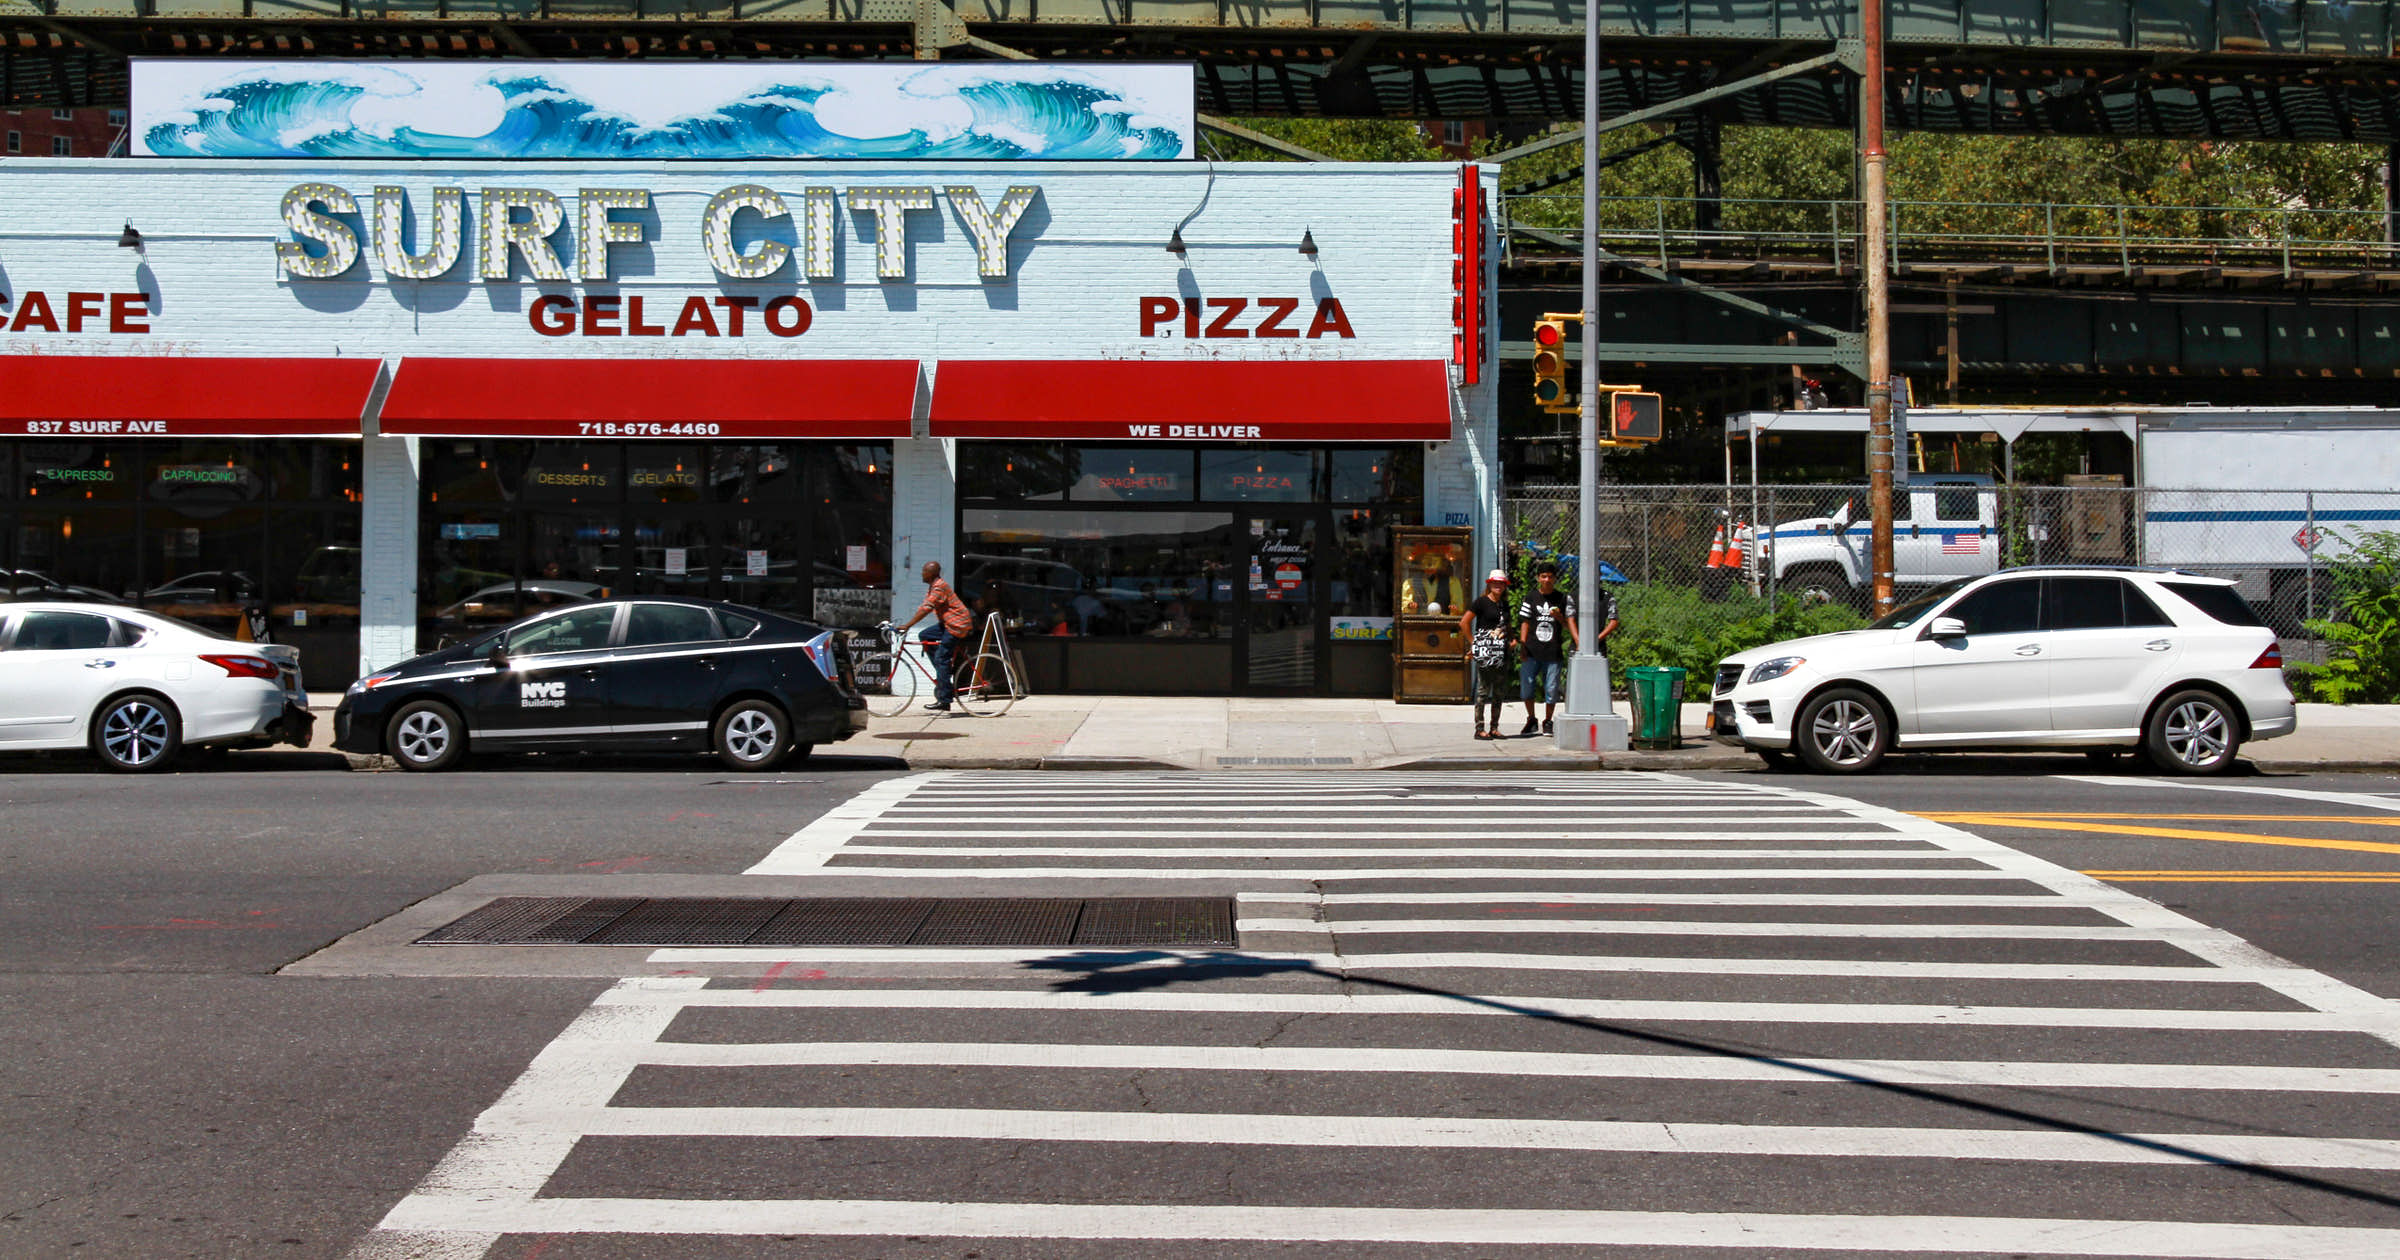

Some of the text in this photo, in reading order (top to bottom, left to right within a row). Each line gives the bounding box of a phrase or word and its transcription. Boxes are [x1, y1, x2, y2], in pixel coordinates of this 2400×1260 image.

[275, 183, 1043, 281] SURF CITY
[0, 291, 150, 334] AFE
[529, 294, 813, 338] GELATO
[1139, 296, 1357, 339] PIZZA
[26, 420, 167, 434] 837 SURF AVE
[578, 422, 721, 436] 718-676-4460
[1128, 424, 1262, 438] WE DELIVER
[47, 468, 114, 482] EXPRESSO
[161, 469, 237, 482] CAPPUCCINO
[537, 472, 608, 487] DESSERTS
[632, 472, 698, 486] GELATO
[1231, 475, 1293, 489] PIZZA
[1099, 476, 1168, 489] SPAGHETTI
[1445, 511, 1471, 525] PIZZA
[1333, 627, 1382, 639] SURF
[520, 681, 567, 699] NYC
[520, 698, 567, 708] Buildings
